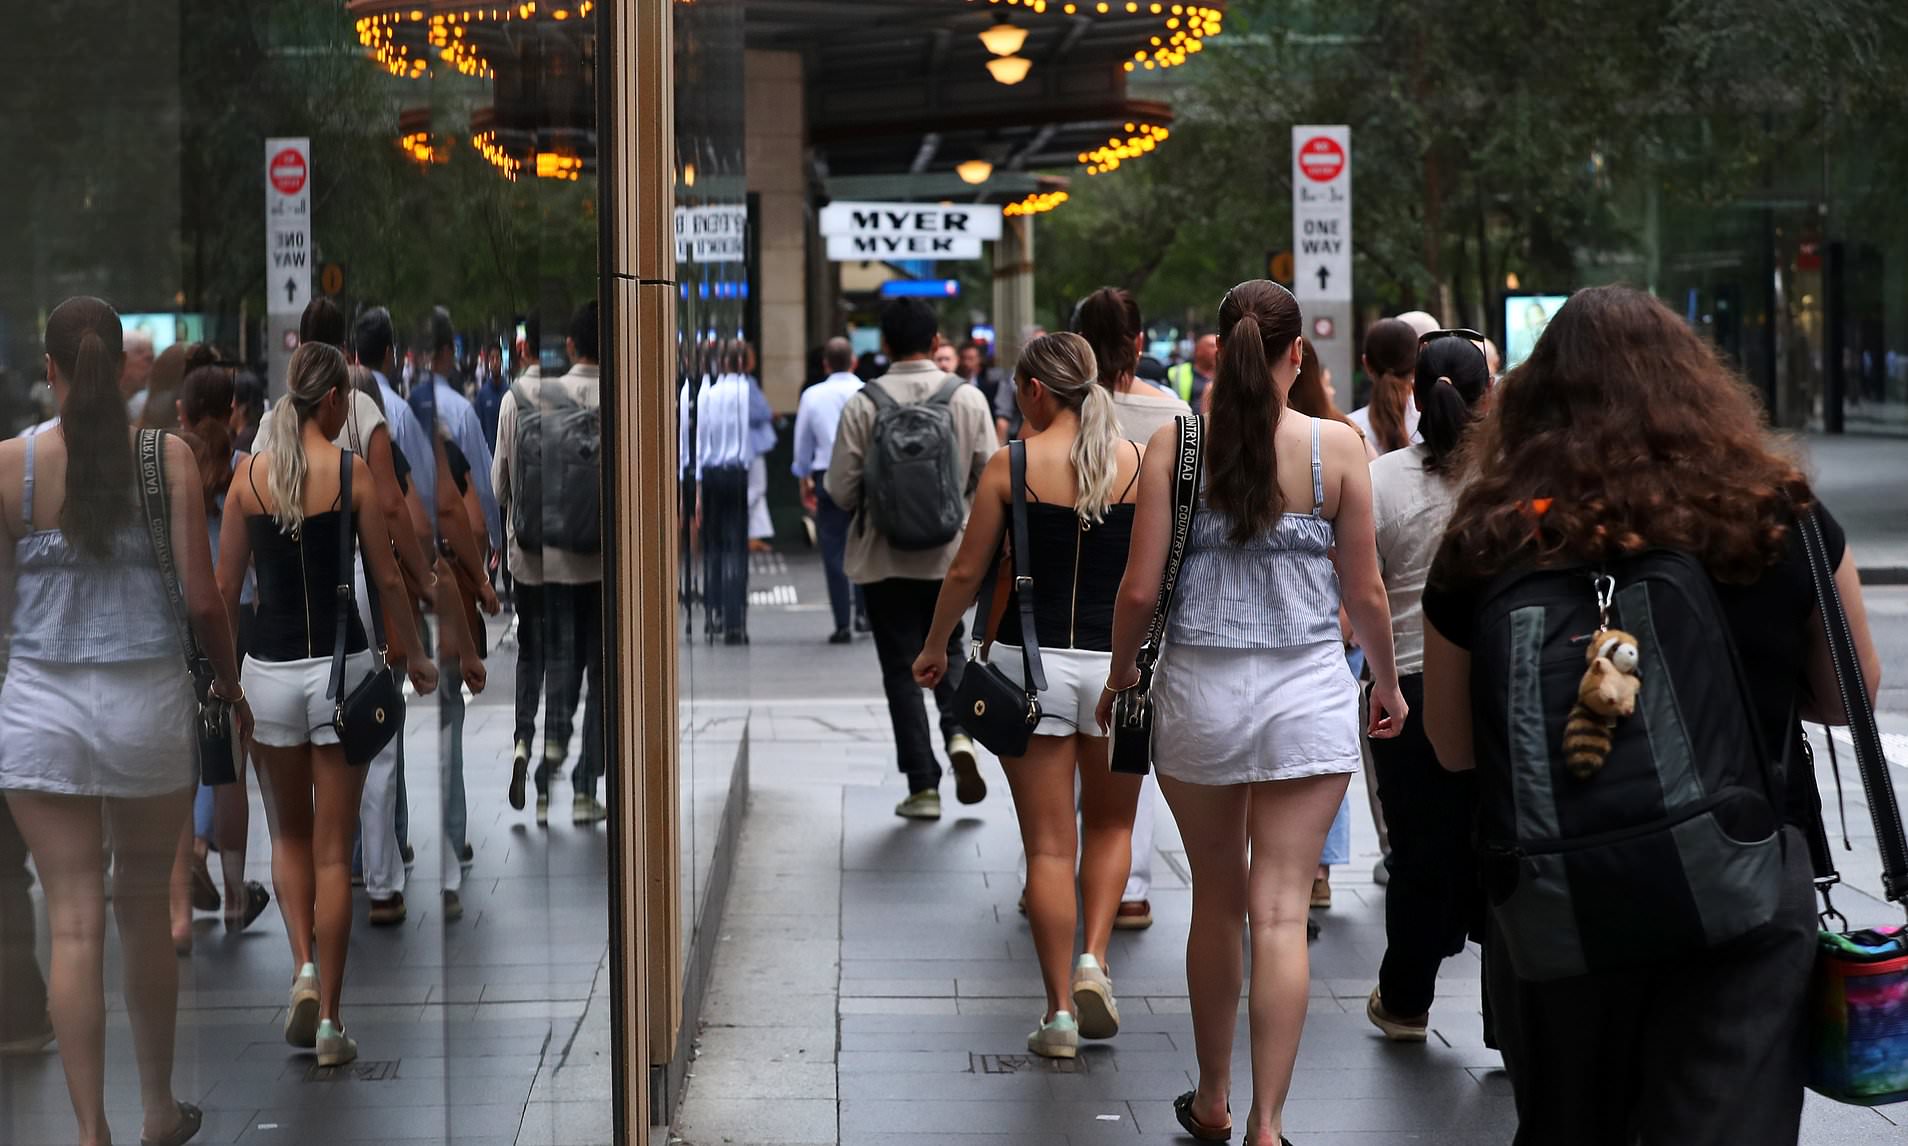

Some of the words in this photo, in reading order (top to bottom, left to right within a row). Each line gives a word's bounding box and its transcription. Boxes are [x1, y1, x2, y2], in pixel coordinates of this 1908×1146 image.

[852, 211, 969, 231] MYER
[1303, 219, 1339, 235] ONE
[1301, 239, 1342, 254] WAY
[1182, 448, 1196, 481] ROAD
[1173, 504, 1188, 558] COUNTRY
[1166, 559, 1178, 591] ROAD
